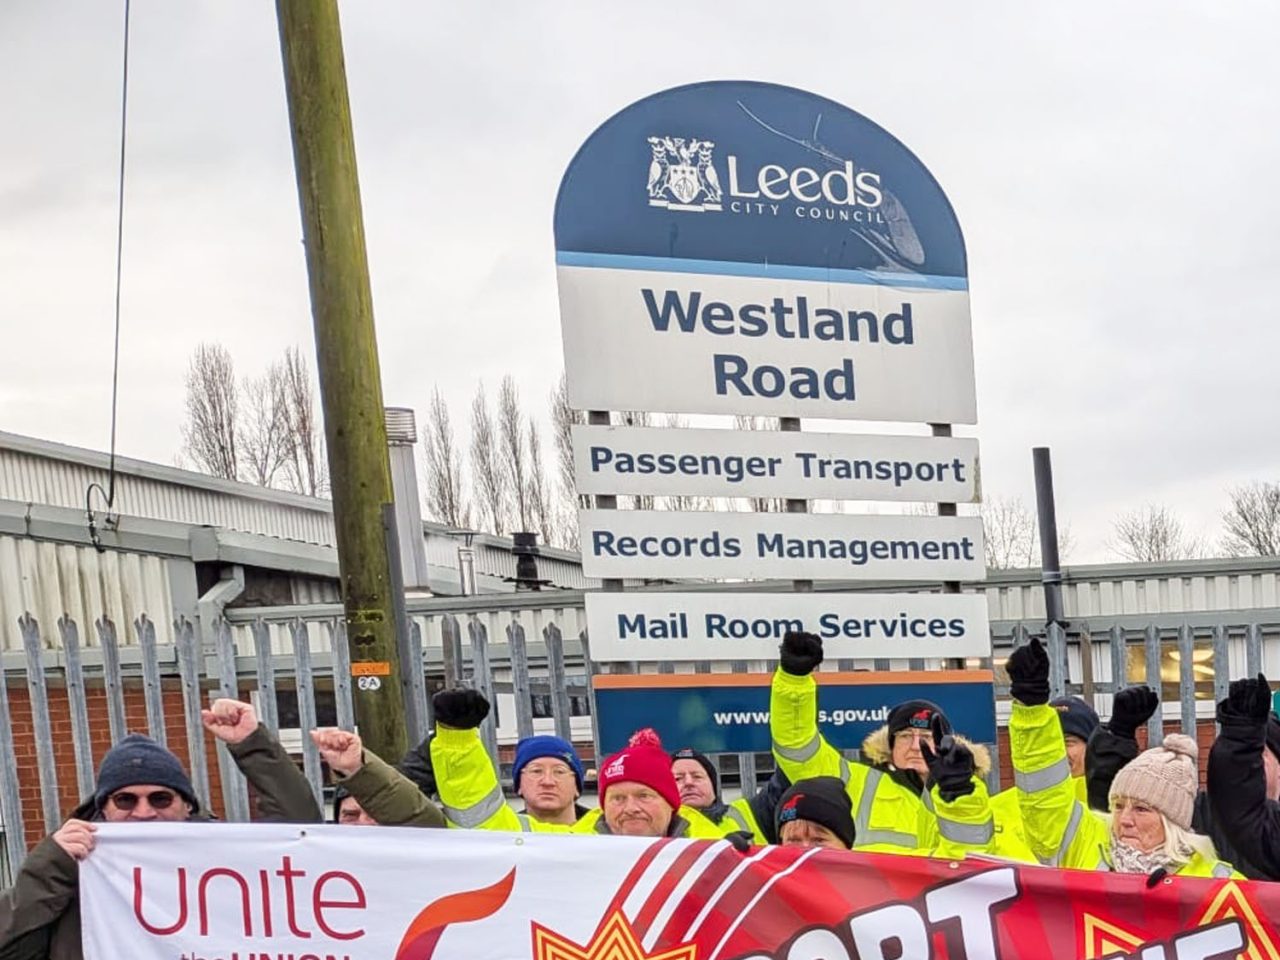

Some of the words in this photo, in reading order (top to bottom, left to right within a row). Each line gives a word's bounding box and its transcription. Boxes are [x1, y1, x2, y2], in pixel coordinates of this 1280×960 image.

[728, 155, 882, 207] Leeds
[731, 202, 780, 216] CITY
[795, 206, 885, 224] COUNCIL
[642, 288, 914, 344] Westland
[714, 354, 856, 401] Road
[590, 447, 781, 482] Passenger
[796, 453, 965, 486] Transport
[592, 531, 741, 558] Records
[757, 533, 975, 565] Management
[618, 613, 688, 639] Mail
[820, 612, 965, 639] Services
[133, 856, 367, 940] unite
